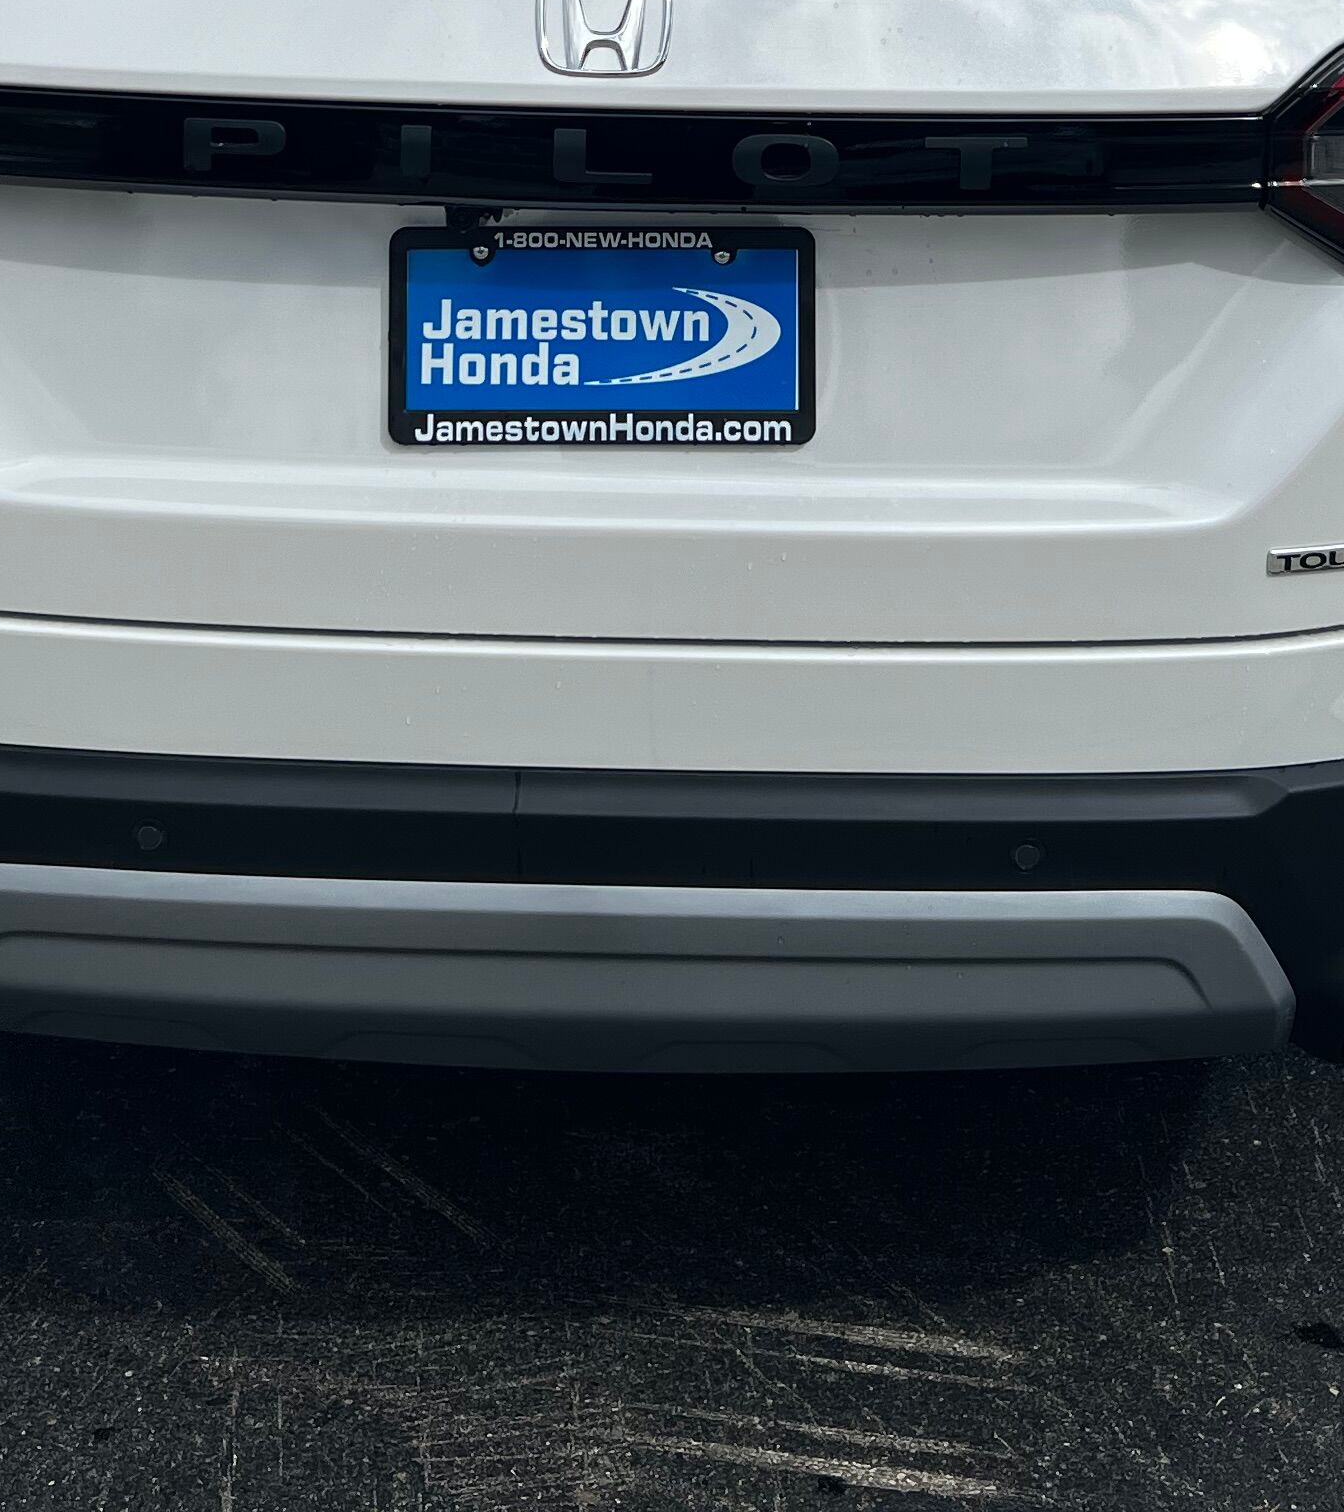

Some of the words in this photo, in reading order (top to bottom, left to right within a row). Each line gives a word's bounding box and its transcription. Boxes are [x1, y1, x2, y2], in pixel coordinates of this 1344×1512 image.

[182, 117, 1030, 190] PILOT
[494, 232, 713, 249] 1-800-NEW-HONDA
[422, 299, 710, 342] Jamestown
[420, 342, 581, 386] Honda
[414, 413, 792, 443] JamestownHonda.com
